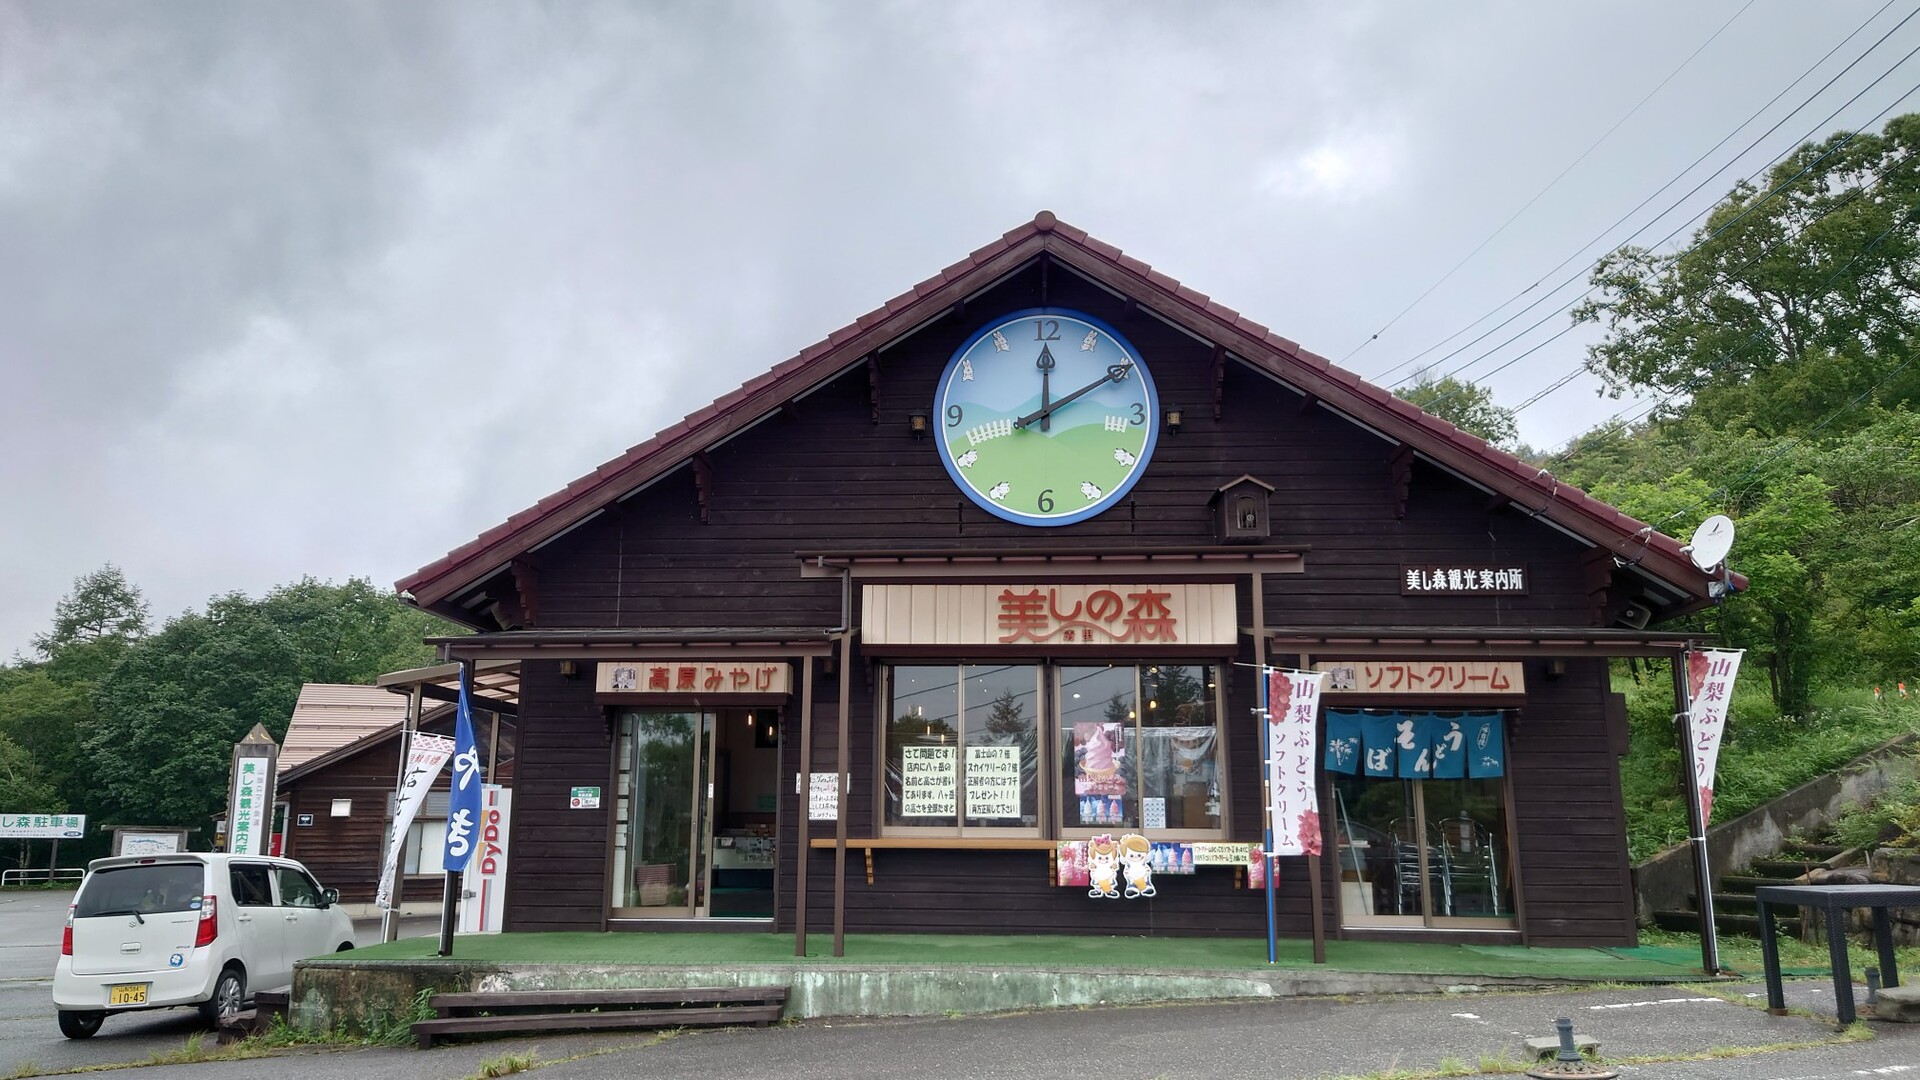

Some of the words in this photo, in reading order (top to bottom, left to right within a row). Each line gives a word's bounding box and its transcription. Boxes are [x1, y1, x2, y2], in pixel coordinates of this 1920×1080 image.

[1034, 320, 1061, 341] 12
[947, 405, 963, 427] 9
[1129, 402, 1145, 425] 3
[1037, 489, 1054, 513] 6
[1406, 568, 1522, 590] 美し森観光案内所
[998, 588, 1178, 642] 美しの森
[649, 666, 778, 690] 高原みやげ
[1364, 666, 1510, 689] ソフトクリーム
[1696, 658, 1732, 777] 山梨ぶどう
[1294, 679, 1315, 802] 山梨ぶどう
[1275, 733, 1294, 847] ソフトクリーム
[234, 763, 255, 854] 美し森観光案内所
[2, 816, 79, 828] し森駐車場
[481, 809, 502, 875] DyDo
[118, 992, 145, 1004] 10-45
